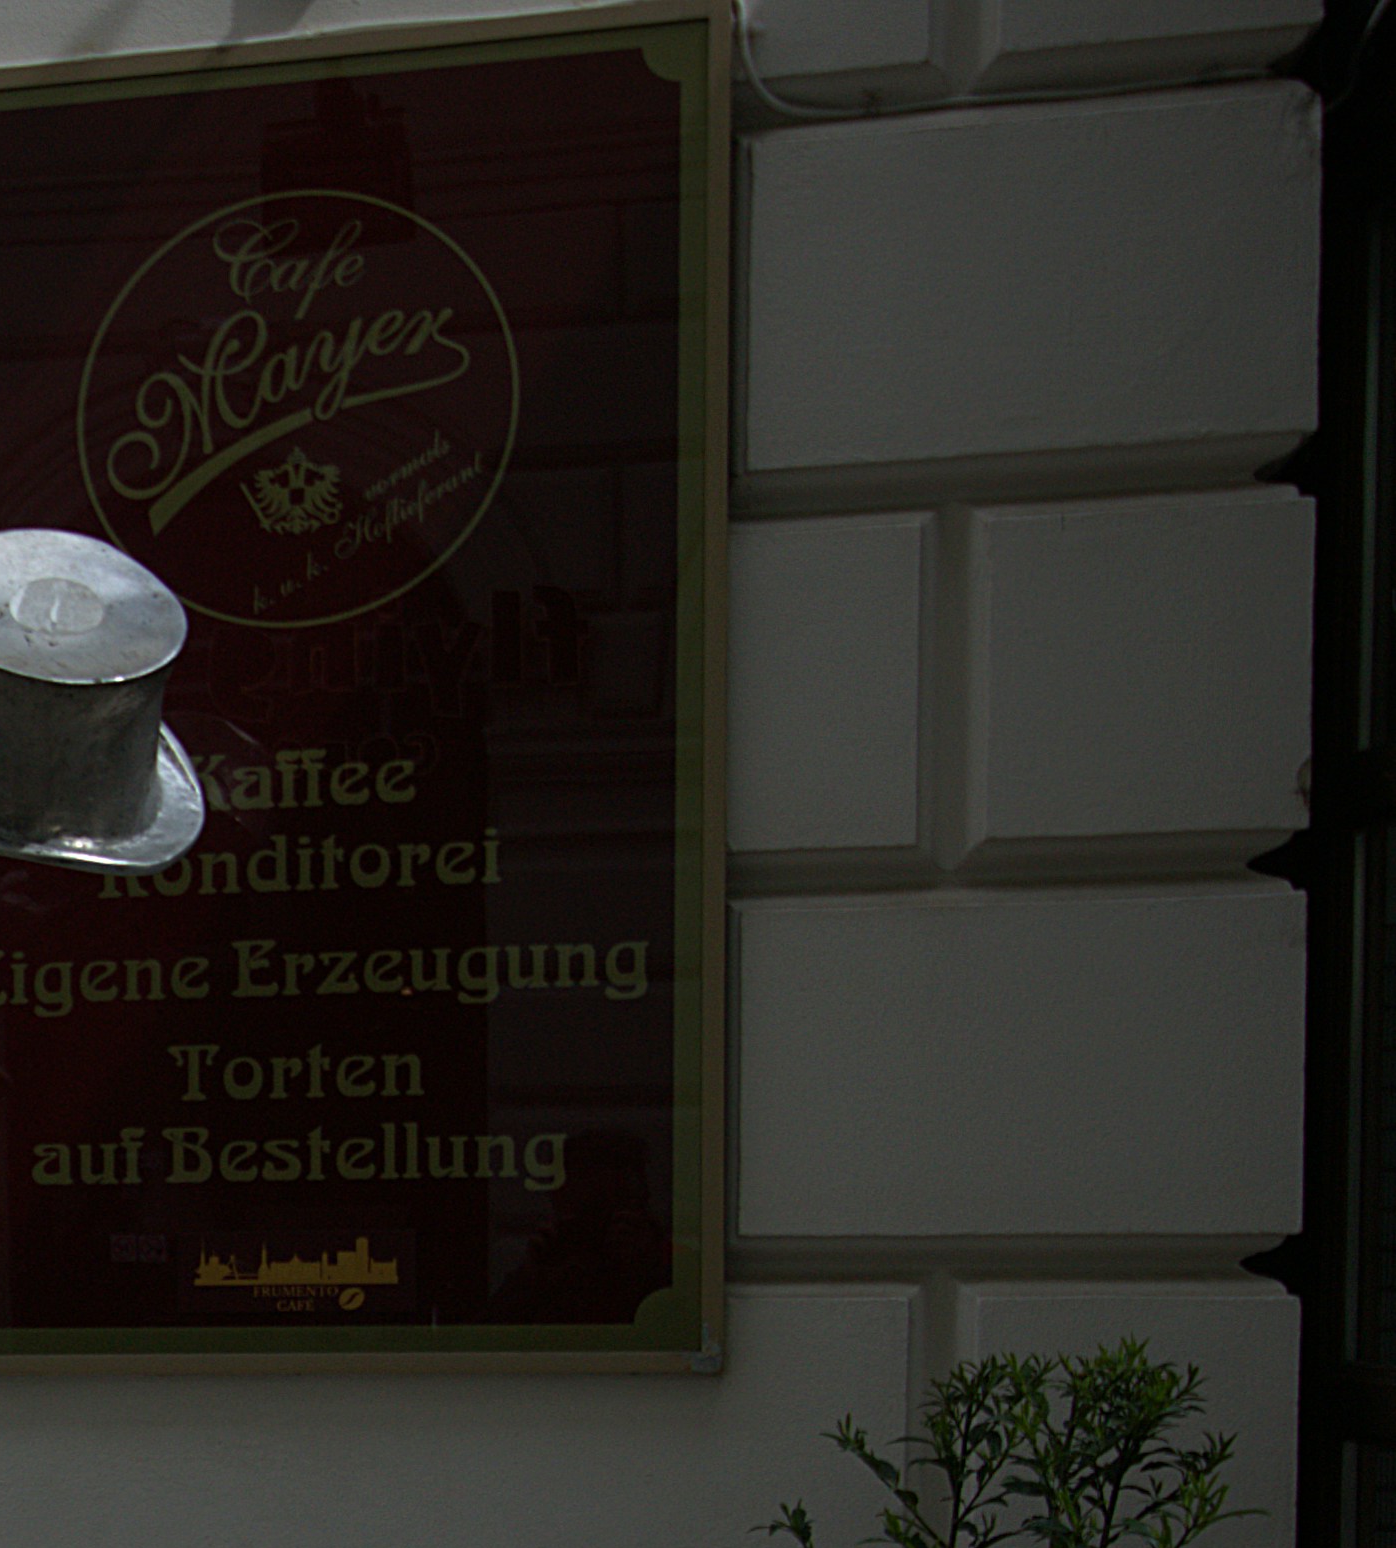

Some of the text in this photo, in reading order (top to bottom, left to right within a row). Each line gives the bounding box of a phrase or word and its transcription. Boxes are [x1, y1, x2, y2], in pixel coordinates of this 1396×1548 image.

[212, 218, 365, 320] Cafe
[106, 305, 471, 500] Mayer
[364, 429, 451, 502] vormals
[333, 451, 484, 560] Hoflieferant
[231, 938, 650, 1004] Erzeugung
[168, 1043, 426, 1102] Torten
[31, 1122, 569, 1191] auf Bestellung
[252, 1285, 340, 1298] FRUMENTO
